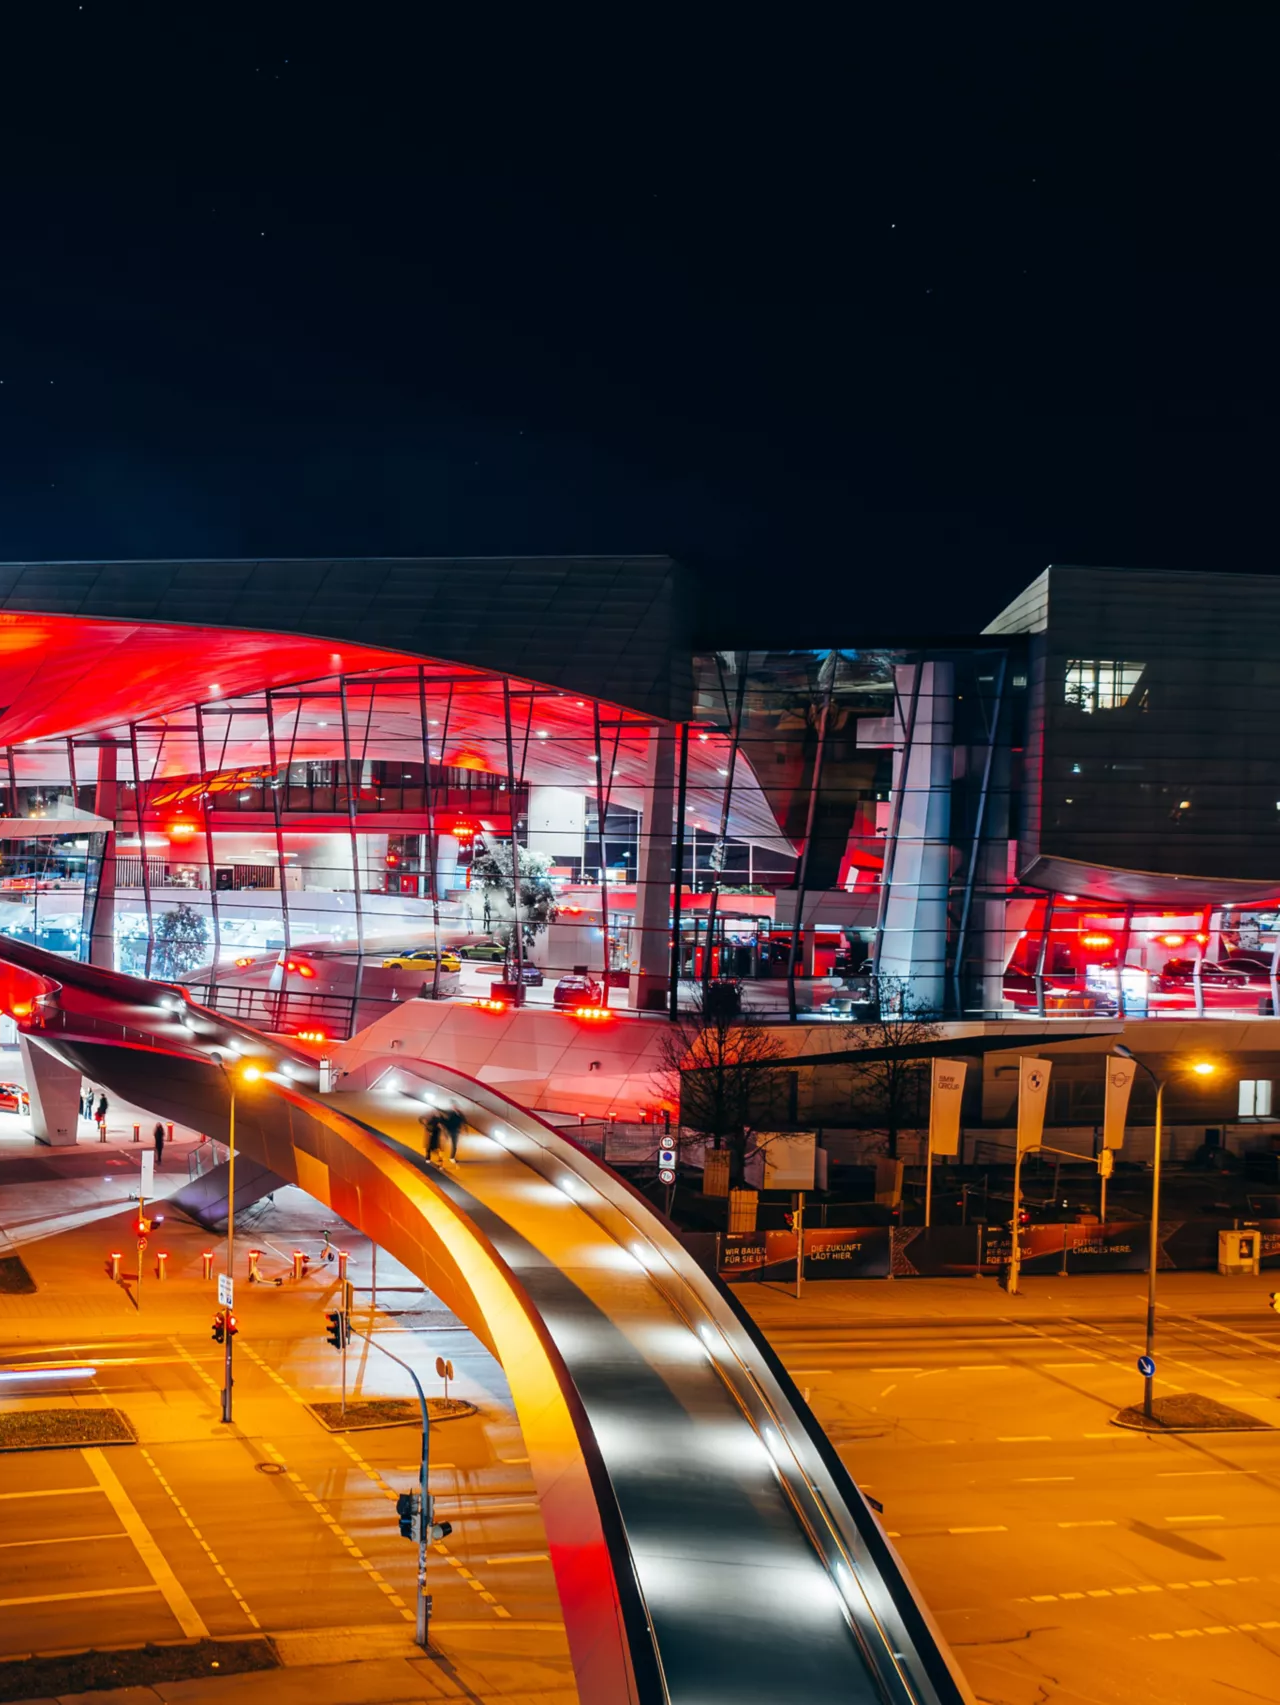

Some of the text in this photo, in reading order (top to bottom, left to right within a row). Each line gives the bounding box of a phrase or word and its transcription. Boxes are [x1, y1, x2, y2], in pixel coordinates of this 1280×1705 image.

[725, 1247, 739, 1255] WIR
[811, 1243, 862, 1253] DIE ZUKUNFT
[725, 1255, 740, 1264] FÜR
[742, 1255, 754, 1263] SIE
